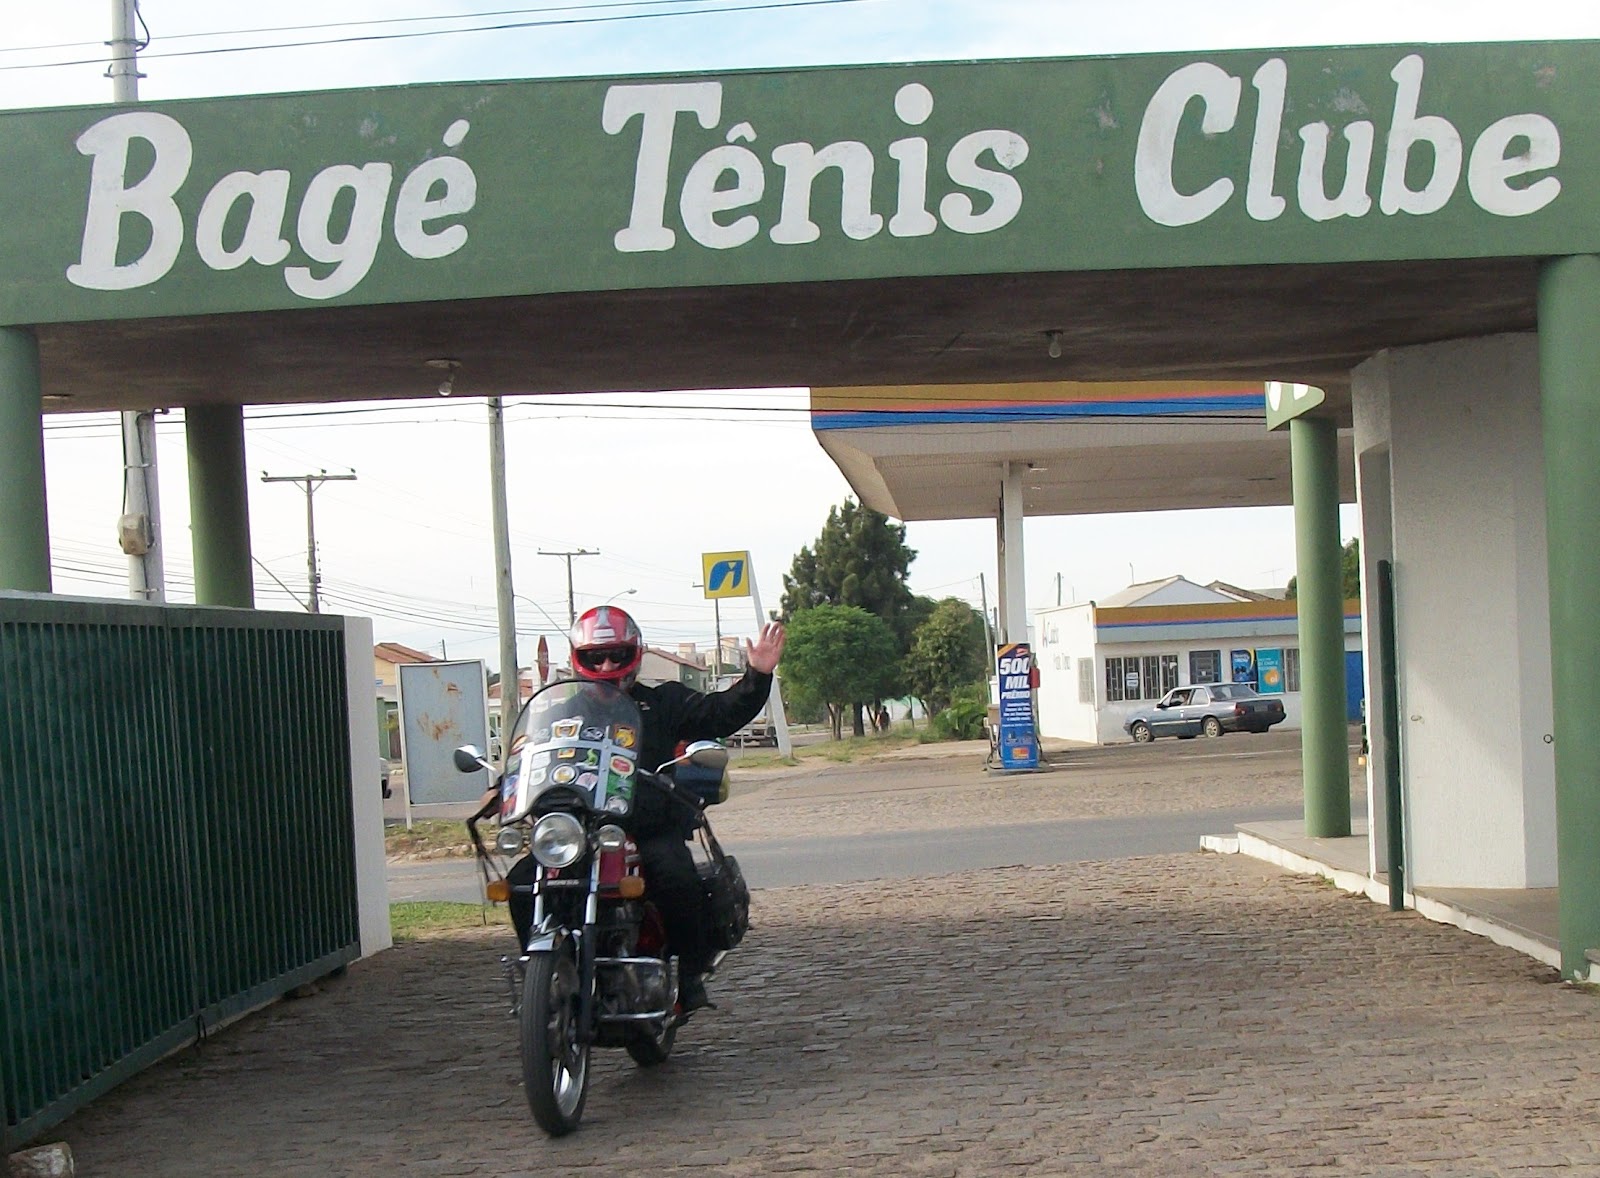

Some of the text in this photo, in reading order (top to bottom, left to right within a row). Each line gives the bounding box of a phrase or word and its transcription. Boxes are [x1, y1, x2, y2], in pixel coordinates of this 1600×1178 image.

[67, 53, 1563, 300] Bagé Tênis Clube
[1005, 675, 1031, 690] MIL
